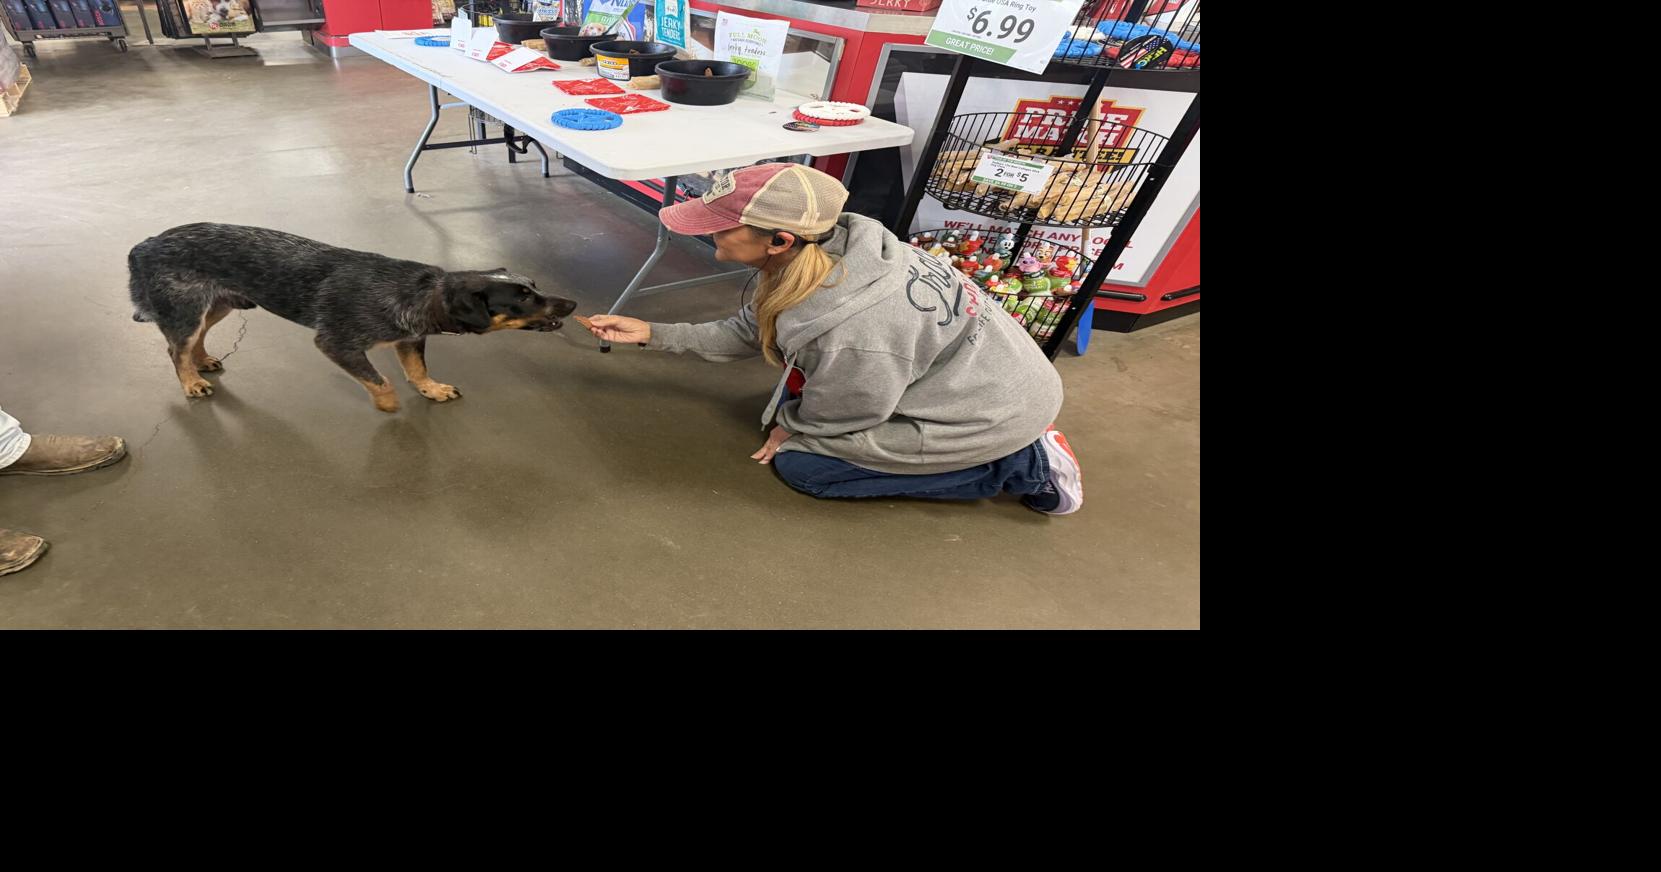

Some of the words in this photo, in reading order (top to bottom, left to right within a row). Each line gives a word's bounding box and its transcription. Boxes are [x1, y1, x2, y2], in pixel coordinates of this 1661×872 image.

[1010, 1, 1024, 10] Ring
[1025, 3, 1037, 13] Toy
[661, 17, 681, 31] JERKY
[966, 6, 1035, 43] $6.99
[945, 37, 969, 50] GREAT
[969, 43, 994, 56] PRICE!
[994, 168, 1004, 177] 2
[1003, 171, 1015, 179] FOR
[1047, 231, 1082, 242] ANY
